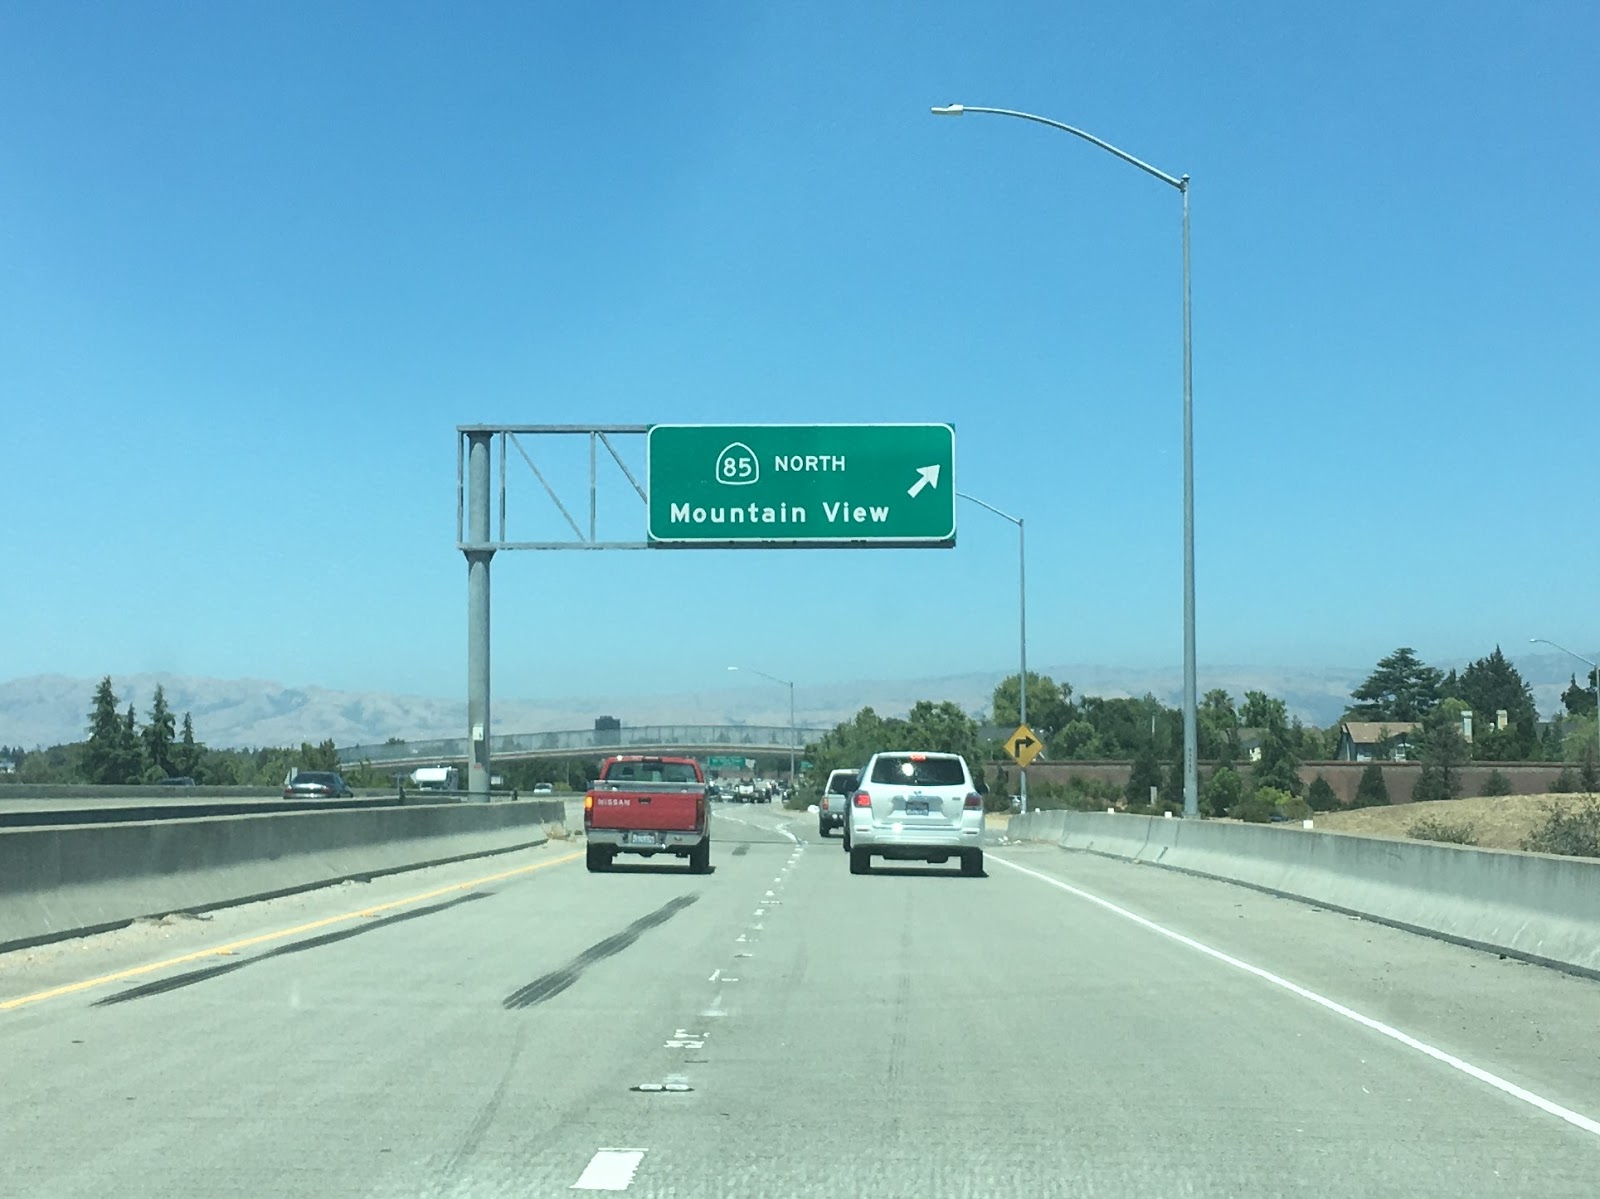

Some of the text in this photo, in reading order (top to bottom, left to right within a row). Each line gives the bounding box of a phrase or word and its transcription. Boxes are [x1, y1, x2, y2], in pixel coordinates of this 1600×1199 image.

[723, 456, 845, 477] 85 NORTH
[671, 502, 889, 522] Mountain View
[597, 798, 630, 806] NISSAN
